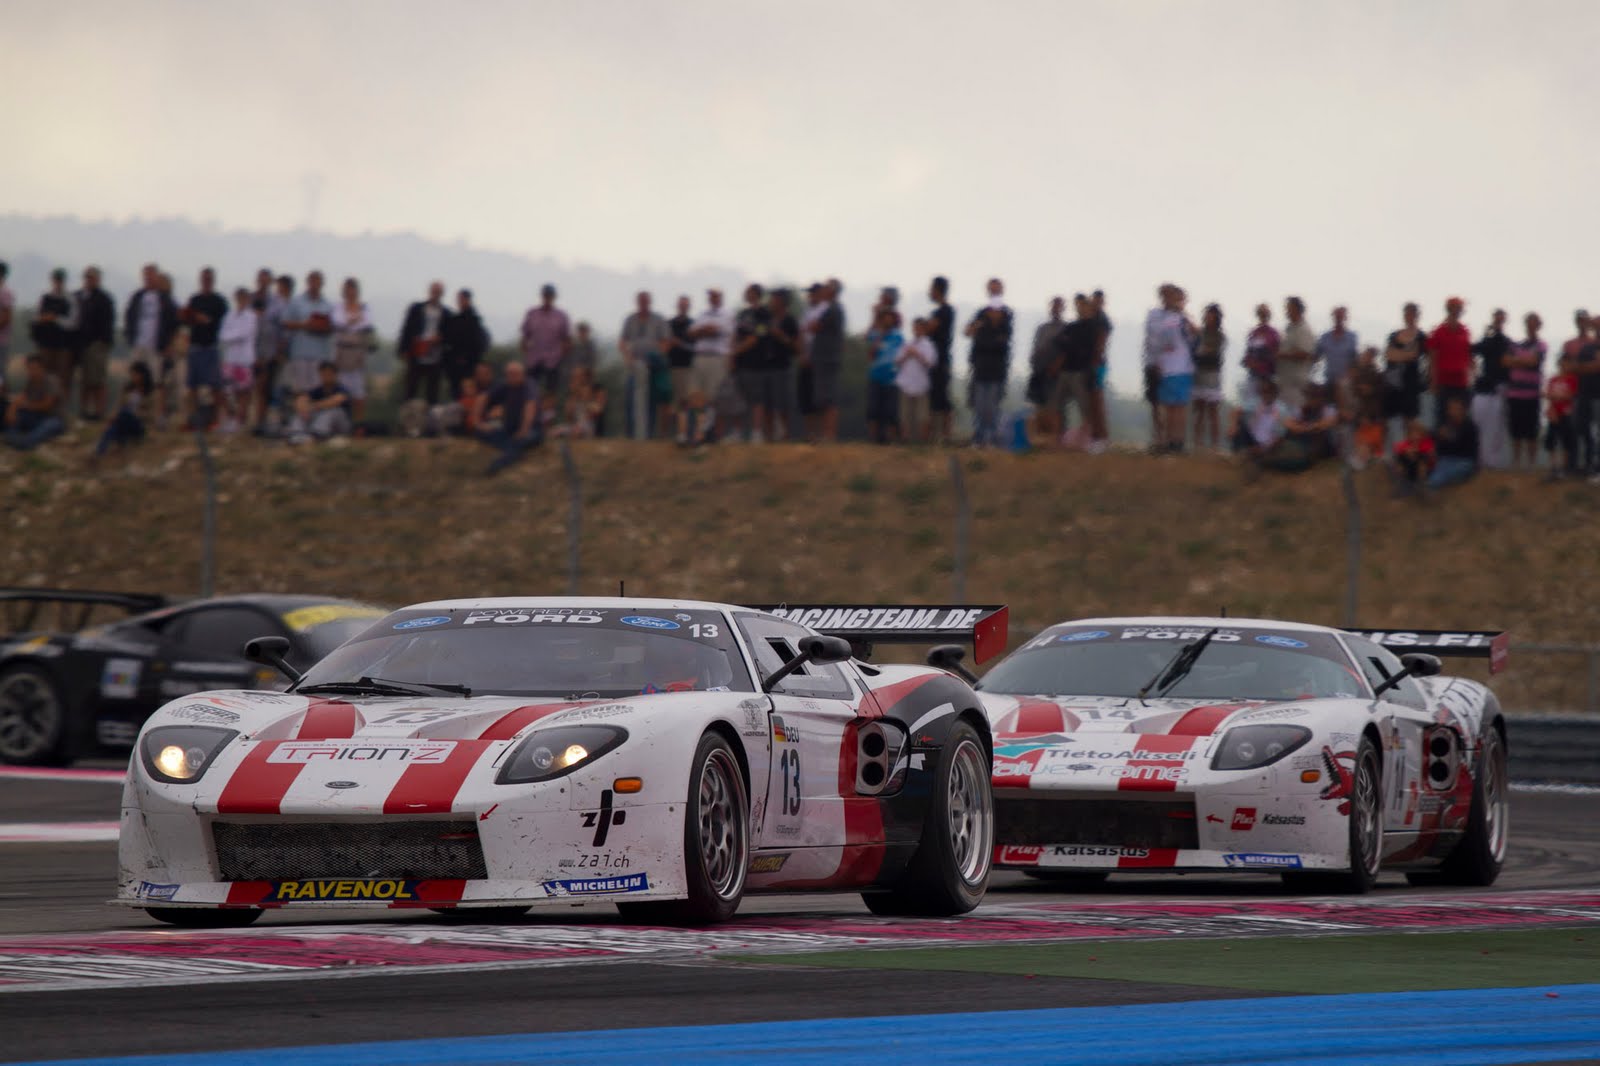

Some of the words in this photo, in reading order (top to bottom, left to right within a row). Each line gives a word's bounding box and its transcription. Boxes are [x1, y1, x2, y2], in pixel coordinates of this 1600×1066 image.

[463, 614, 603, 625] FORD
[469, 608, 573, 617] POWERED
[688, 623, 719, 638] 13
[1120, 631, 1242, 642] FORD
[1080, 709, 1137, 721] 14
[785, 726, 800, 743] DEU
[781, 748, 801, 817] 13
[1053, 845, 1149, 858] Katsastus
[277, 880, 412, 899] RAVENOL
[570, 876, 642, 891] MICHELIN
